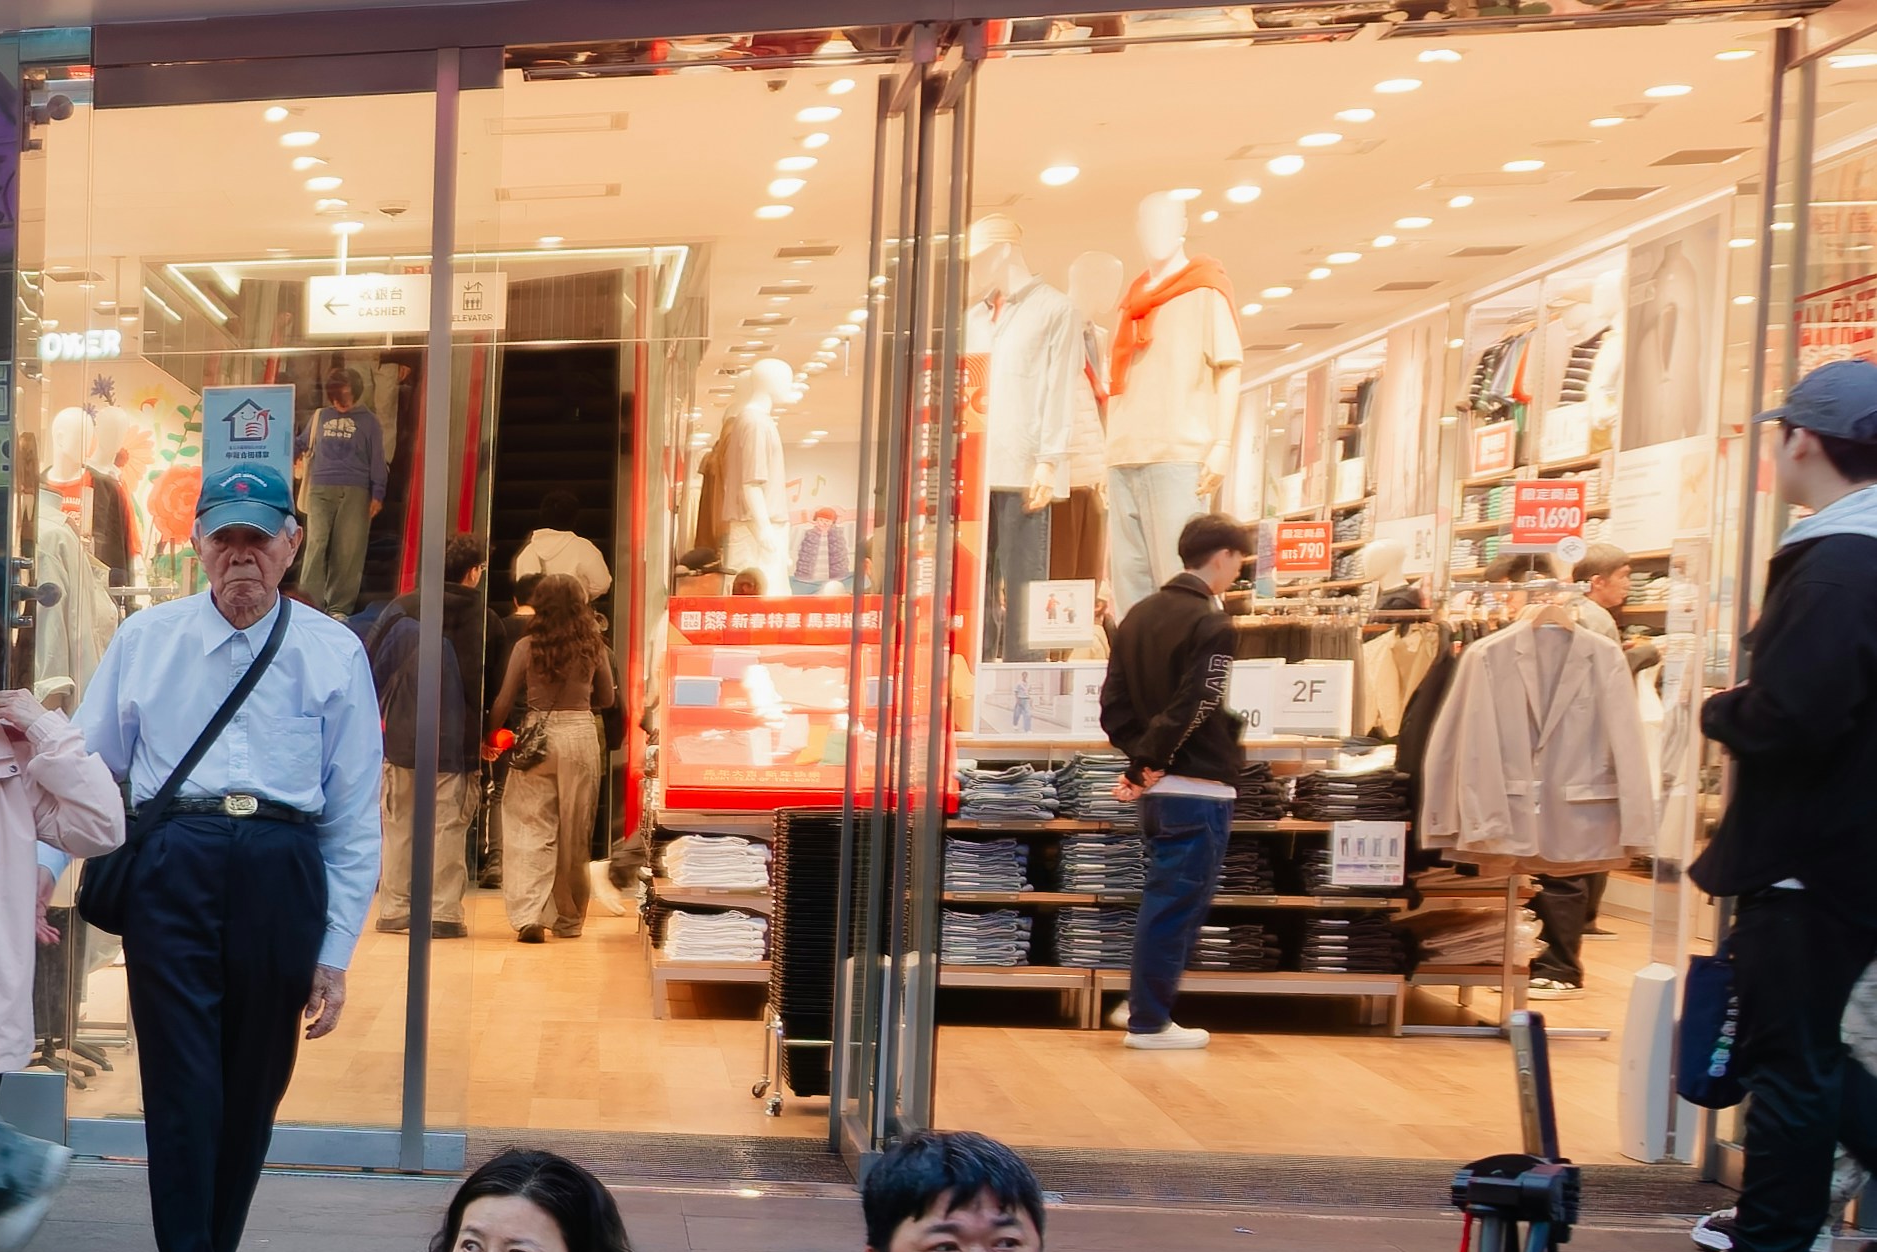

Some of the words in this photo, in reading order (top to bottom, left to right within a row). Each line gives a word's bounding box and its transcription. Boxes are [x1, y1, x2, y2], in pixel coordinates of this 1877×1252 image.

[360, 286, 403, 300] 收銀台
[358, 306, 406, 316] CASHIER
[1538, 507, 1581, 530] 1,690
[1299, 542, 1325, 559] 790
[731, 612, 801, 629] 新春特惠
[1292, 679, 1327, 703] 2F
